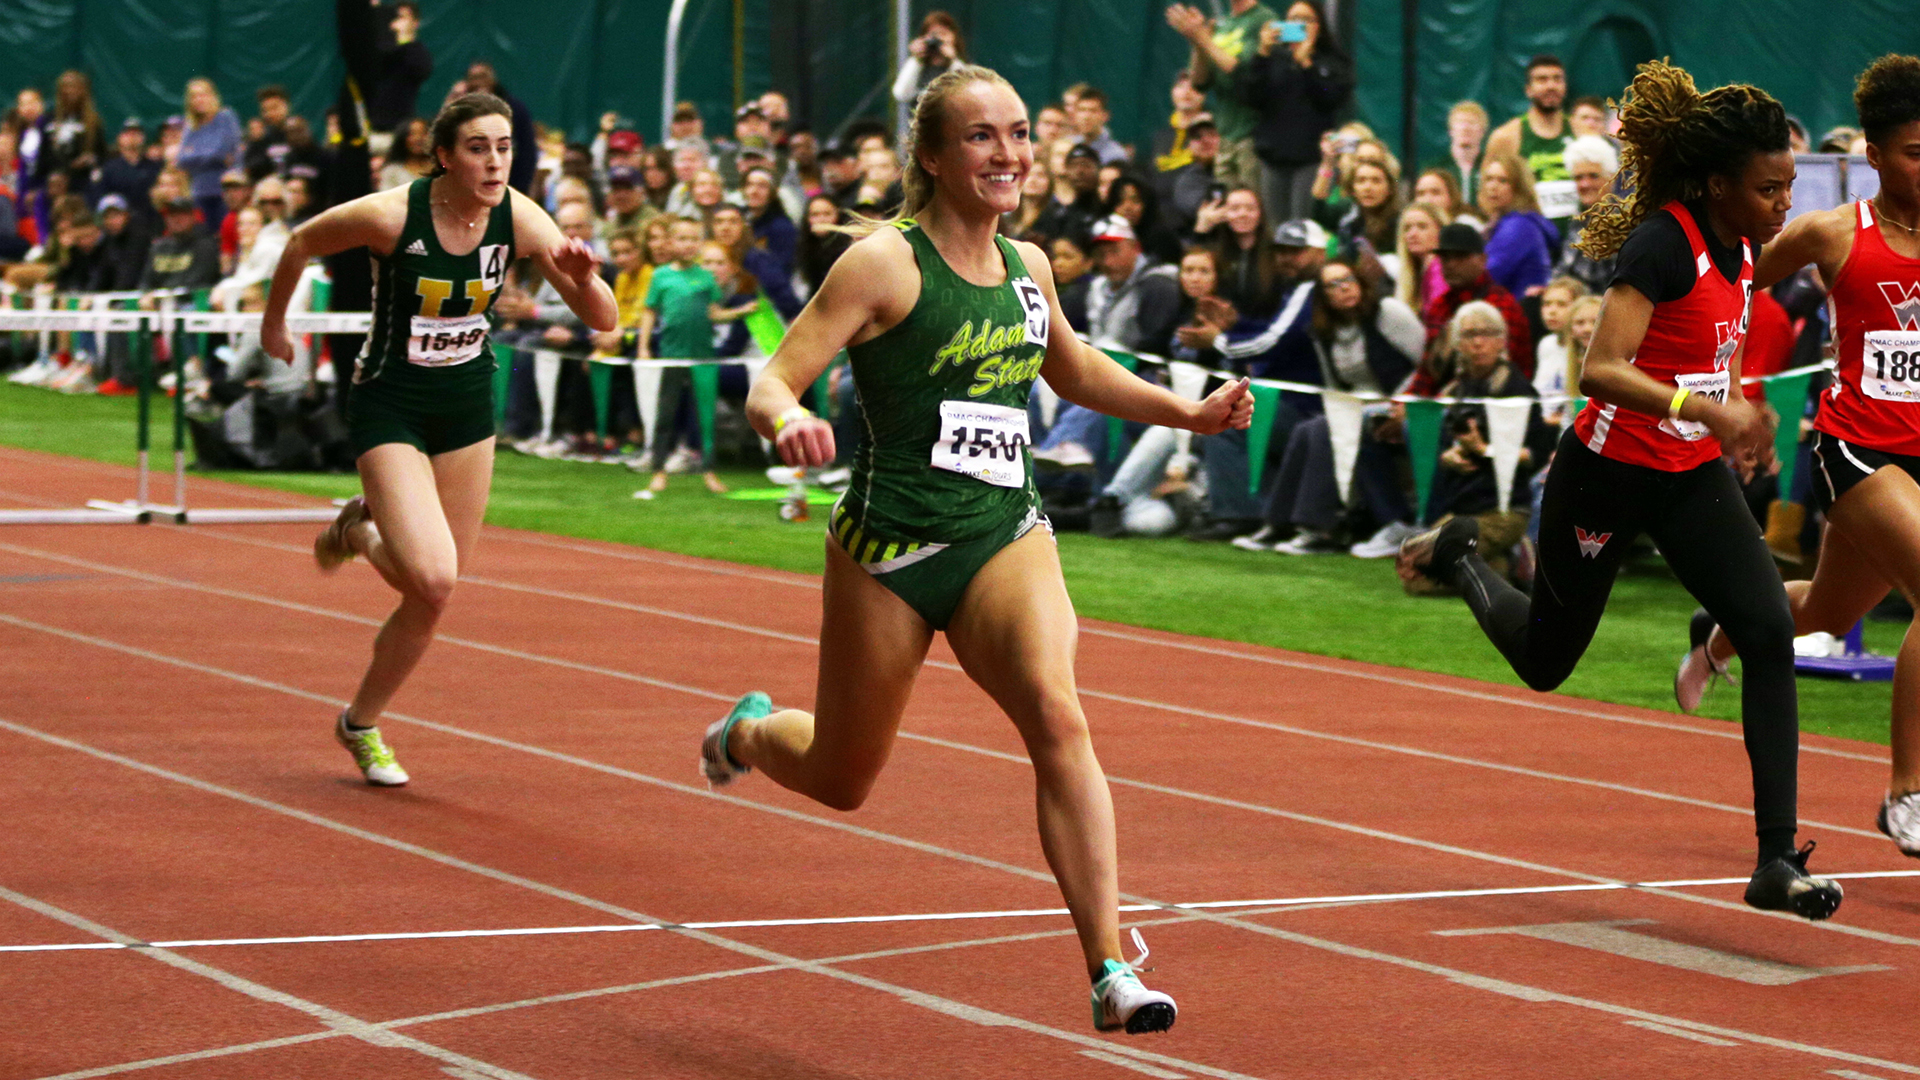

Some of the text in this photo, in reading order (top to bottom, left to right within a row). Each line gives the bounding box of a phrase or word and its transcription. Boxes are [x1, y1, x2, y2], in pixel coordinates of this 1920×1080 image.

[485, 246, 501, 284] 4
[1020, 286, 1046, 339] 5
[929, 319, 1027, 376] Adam
